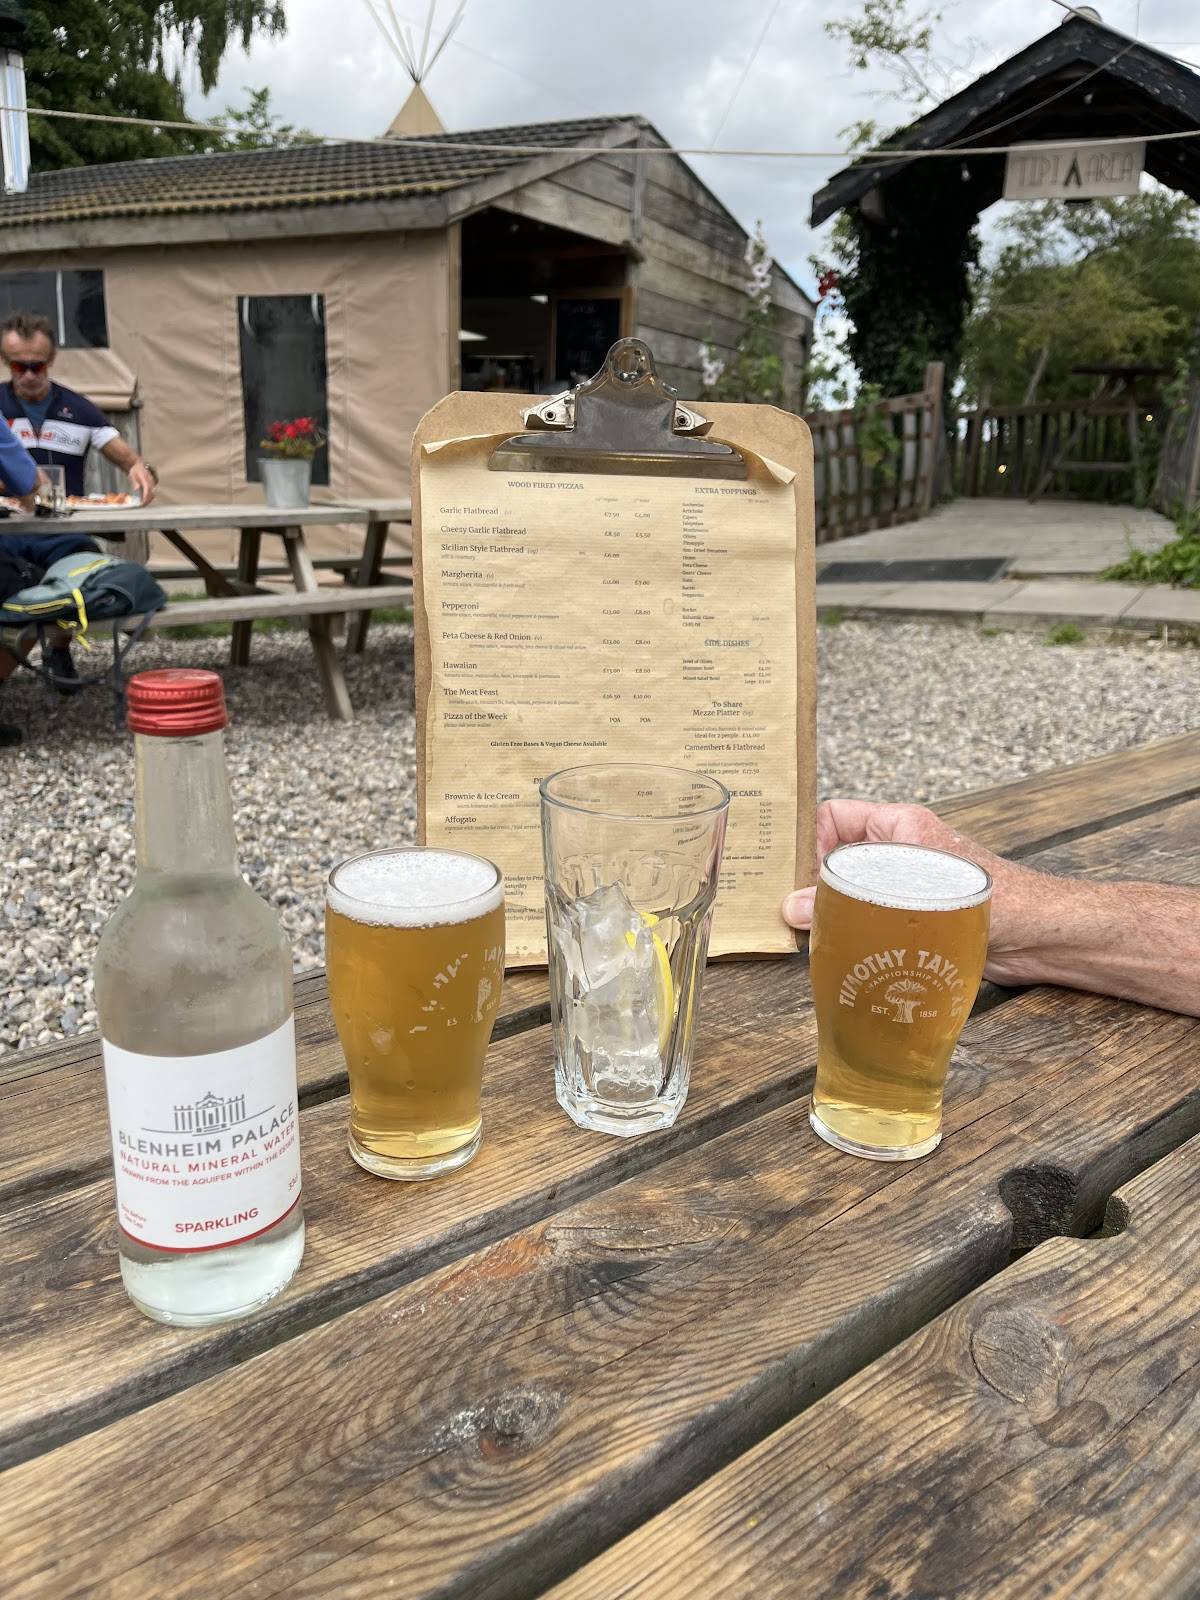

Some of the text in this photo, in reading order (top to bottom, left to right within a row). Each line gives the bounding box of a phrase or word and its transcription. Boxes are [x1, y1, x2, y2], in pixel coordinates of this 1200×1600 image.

[1086, 152, 1134, 183] AREA
[508, 481, 531, 489] WOOD
[463, 507, 499, 515] Flatbread
[441, 526, 468, 534] Cheesy
[492, 527, 527, 535] Flatbread
[441, 544, 469, 552] Sicilian
[470, 545, 488, 553] Style
[441, 570, 483, 579] Margherita
[442, 602, 479, 610] Pepperoni
[459, 632, 486, 640] Cheese
[444, 688, 458, 696] The
[445, 816, 477, 824] Affogato
[839, 949, 906, 1008] TIMOTHY
[871, 1005, 937, 1018] EST. 1858
[118, 1102, 294, 1157] BLENHEIM PALACE
[120, 1121, 295, 1174] NATURAL MINERAL WATER
[146, 1176, 169, 1186] FROM
[192, 1172, 232, 1185] AQUIFER
[234, 1161, 264, 1178] WITHIN
[265, 1154, 278, 1167] THE
[175, 1207, 259, 1233] SPARKLING
